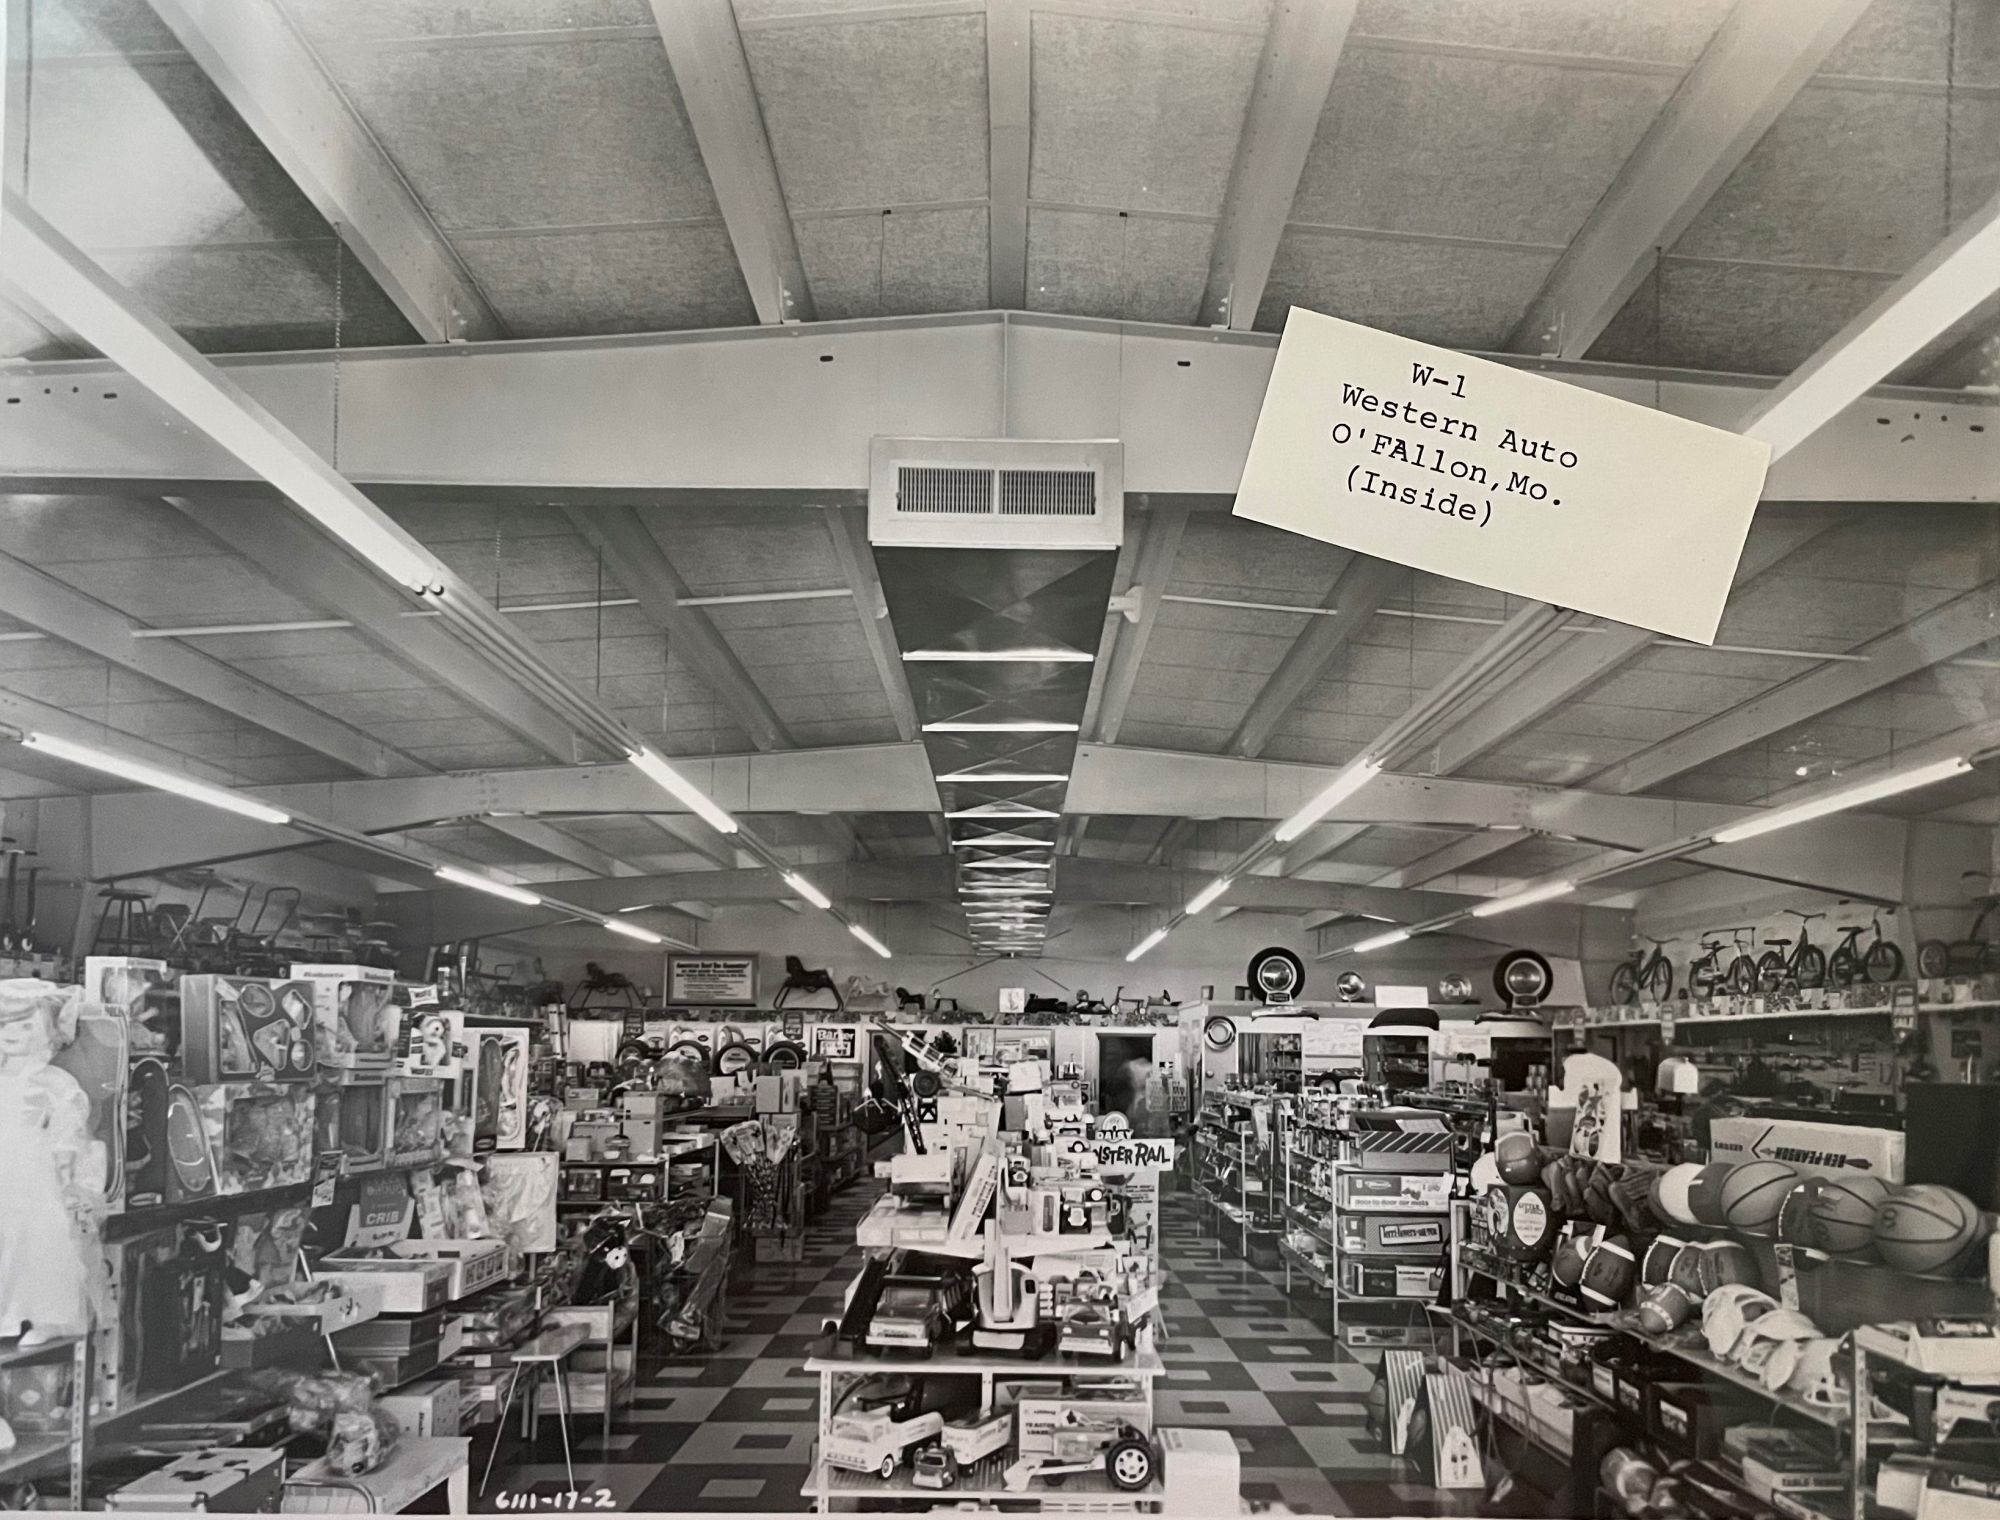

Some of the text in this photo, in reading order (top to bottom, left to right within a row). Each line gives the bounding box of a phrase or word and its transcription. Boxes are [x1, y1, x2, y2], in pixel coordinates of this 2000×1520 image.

[1095, 1130, 1134, 1140] DAISY
[1093, 1142, 1171, 1167] LSTER RAIL
[366, 1210, 400, 1225] CRIB
